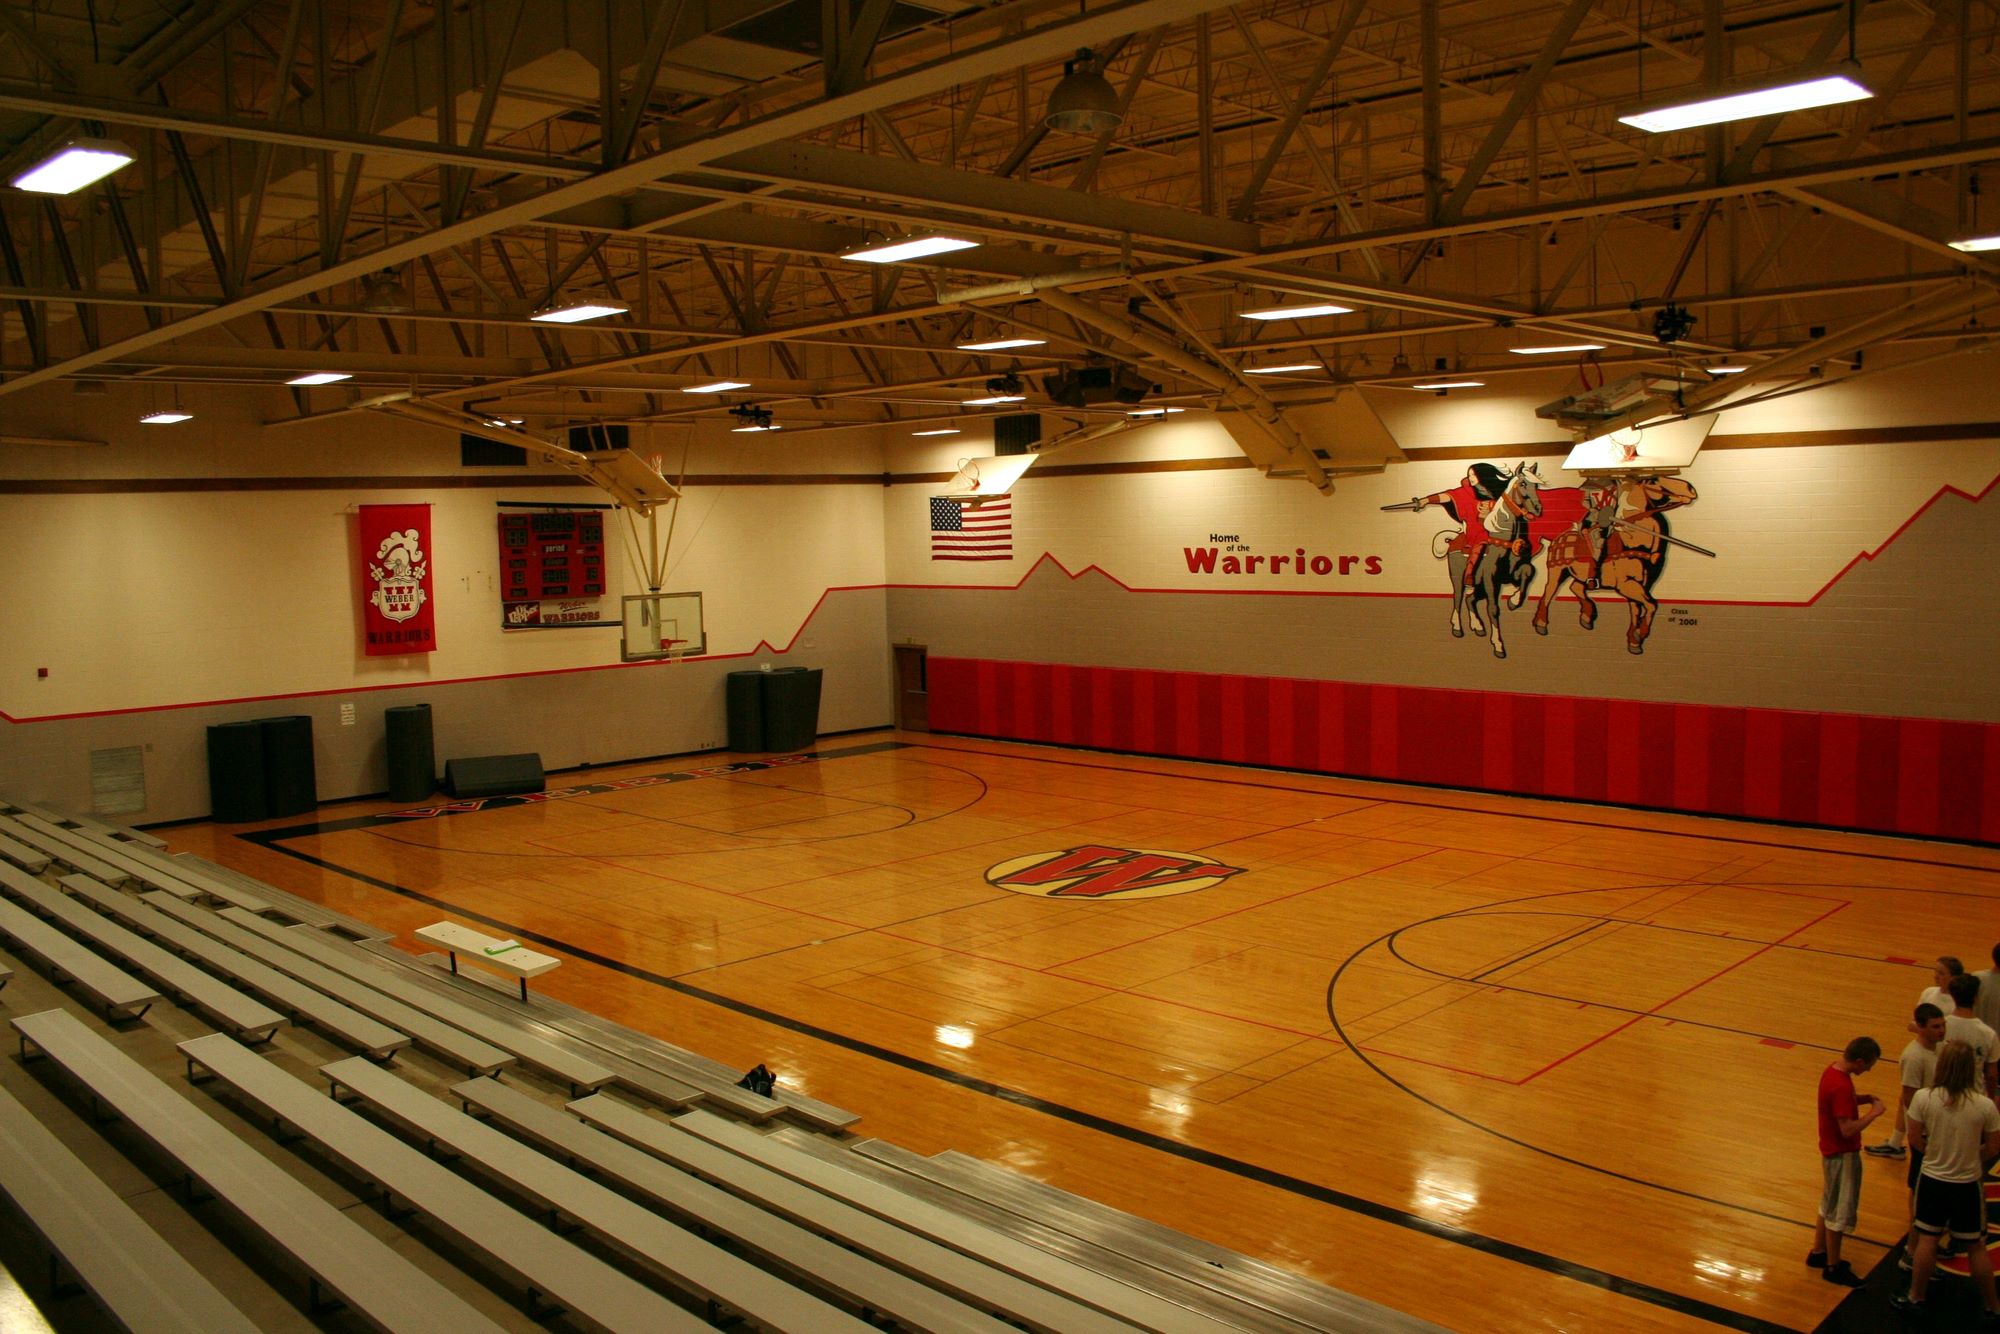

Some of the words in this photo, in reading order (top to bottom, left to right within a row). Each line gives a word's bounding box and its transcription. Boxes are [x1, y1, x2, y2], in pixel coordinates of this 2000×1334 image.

[1209, 533, 1240, 543] Home
[545, 544, 566, 553] period
[1226, 543, 1235, 552] of
[1237, 543, 1250, 552] the
[1183, 547, 1384, 575] Warriors
[384, 594, 415, 603] WEBER
[543, 611, 600, 624] WARRIORS
[1679, 618, 1698, 626] 2001
[368, 629, 431, 644] WARRIORS
[373, 753, 830, 818] WEBER
